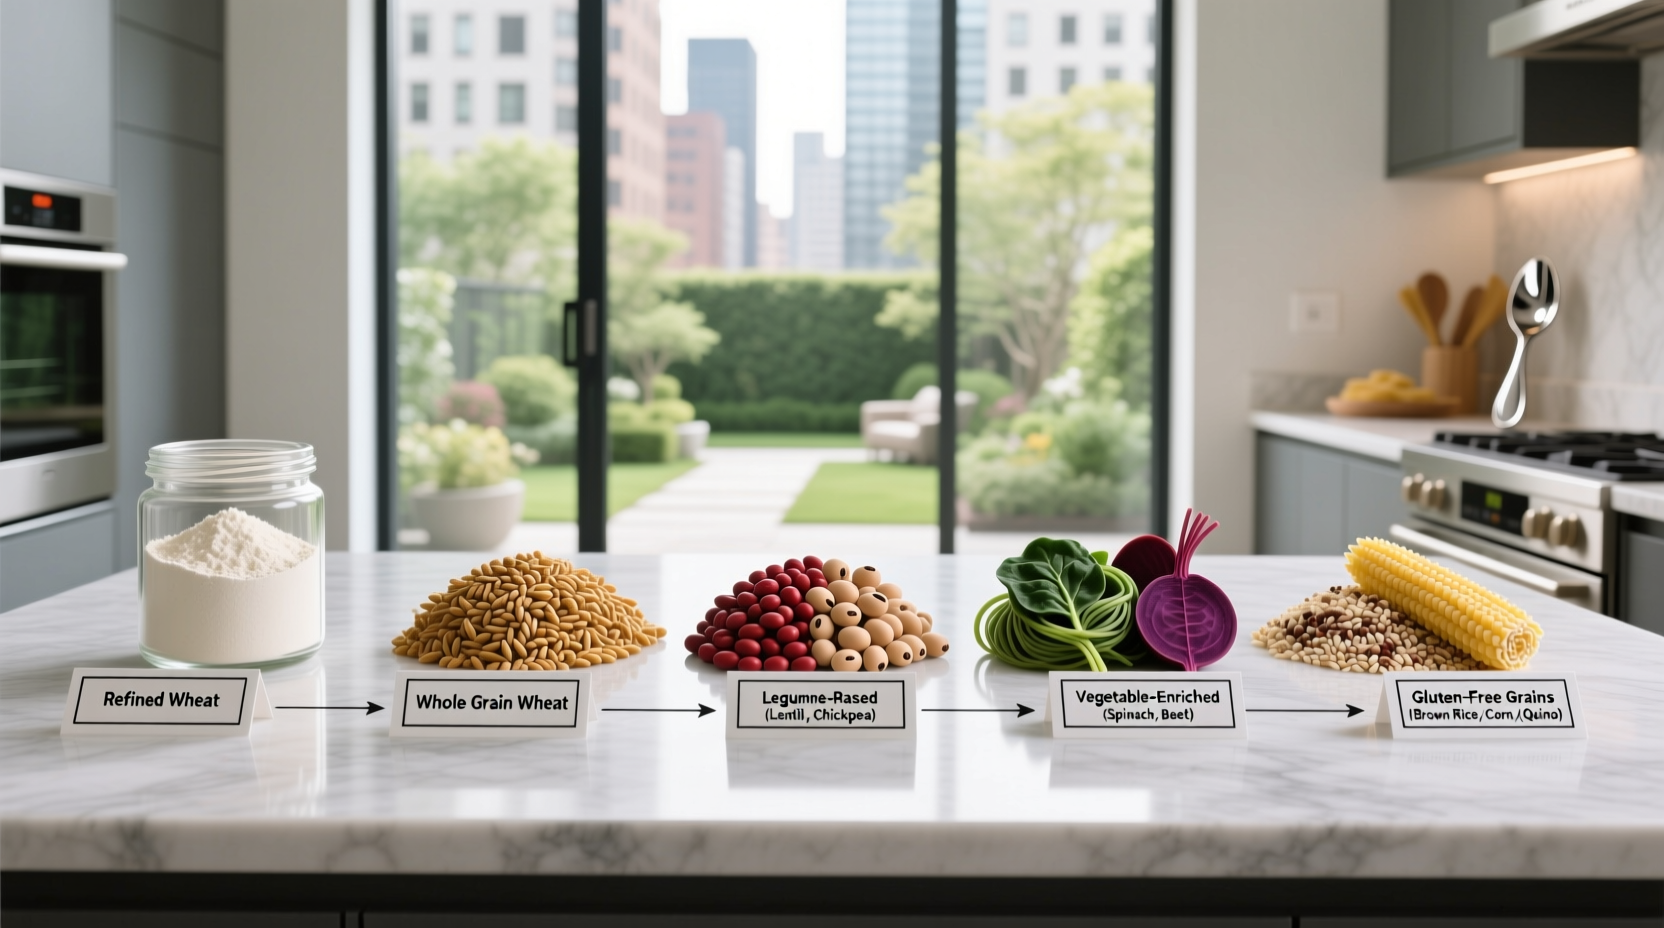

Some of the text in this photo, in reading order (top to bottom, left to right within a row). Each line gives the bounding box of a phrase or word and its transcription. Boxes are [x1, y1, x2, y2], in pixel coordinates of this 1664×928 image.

[103, 690, 221, 708] Refined Wheat
[416, 693, 569, 711] Whole Grain Wheat
[1075, 689, 1220, 707] Vegetable-Enriched
[1411, 689, 1555, 704] Gluten-Free Grains
[813, 708, 876, 725] Chickpea)
[1102, 707, 1194, 724] (Spinach, Beet)
